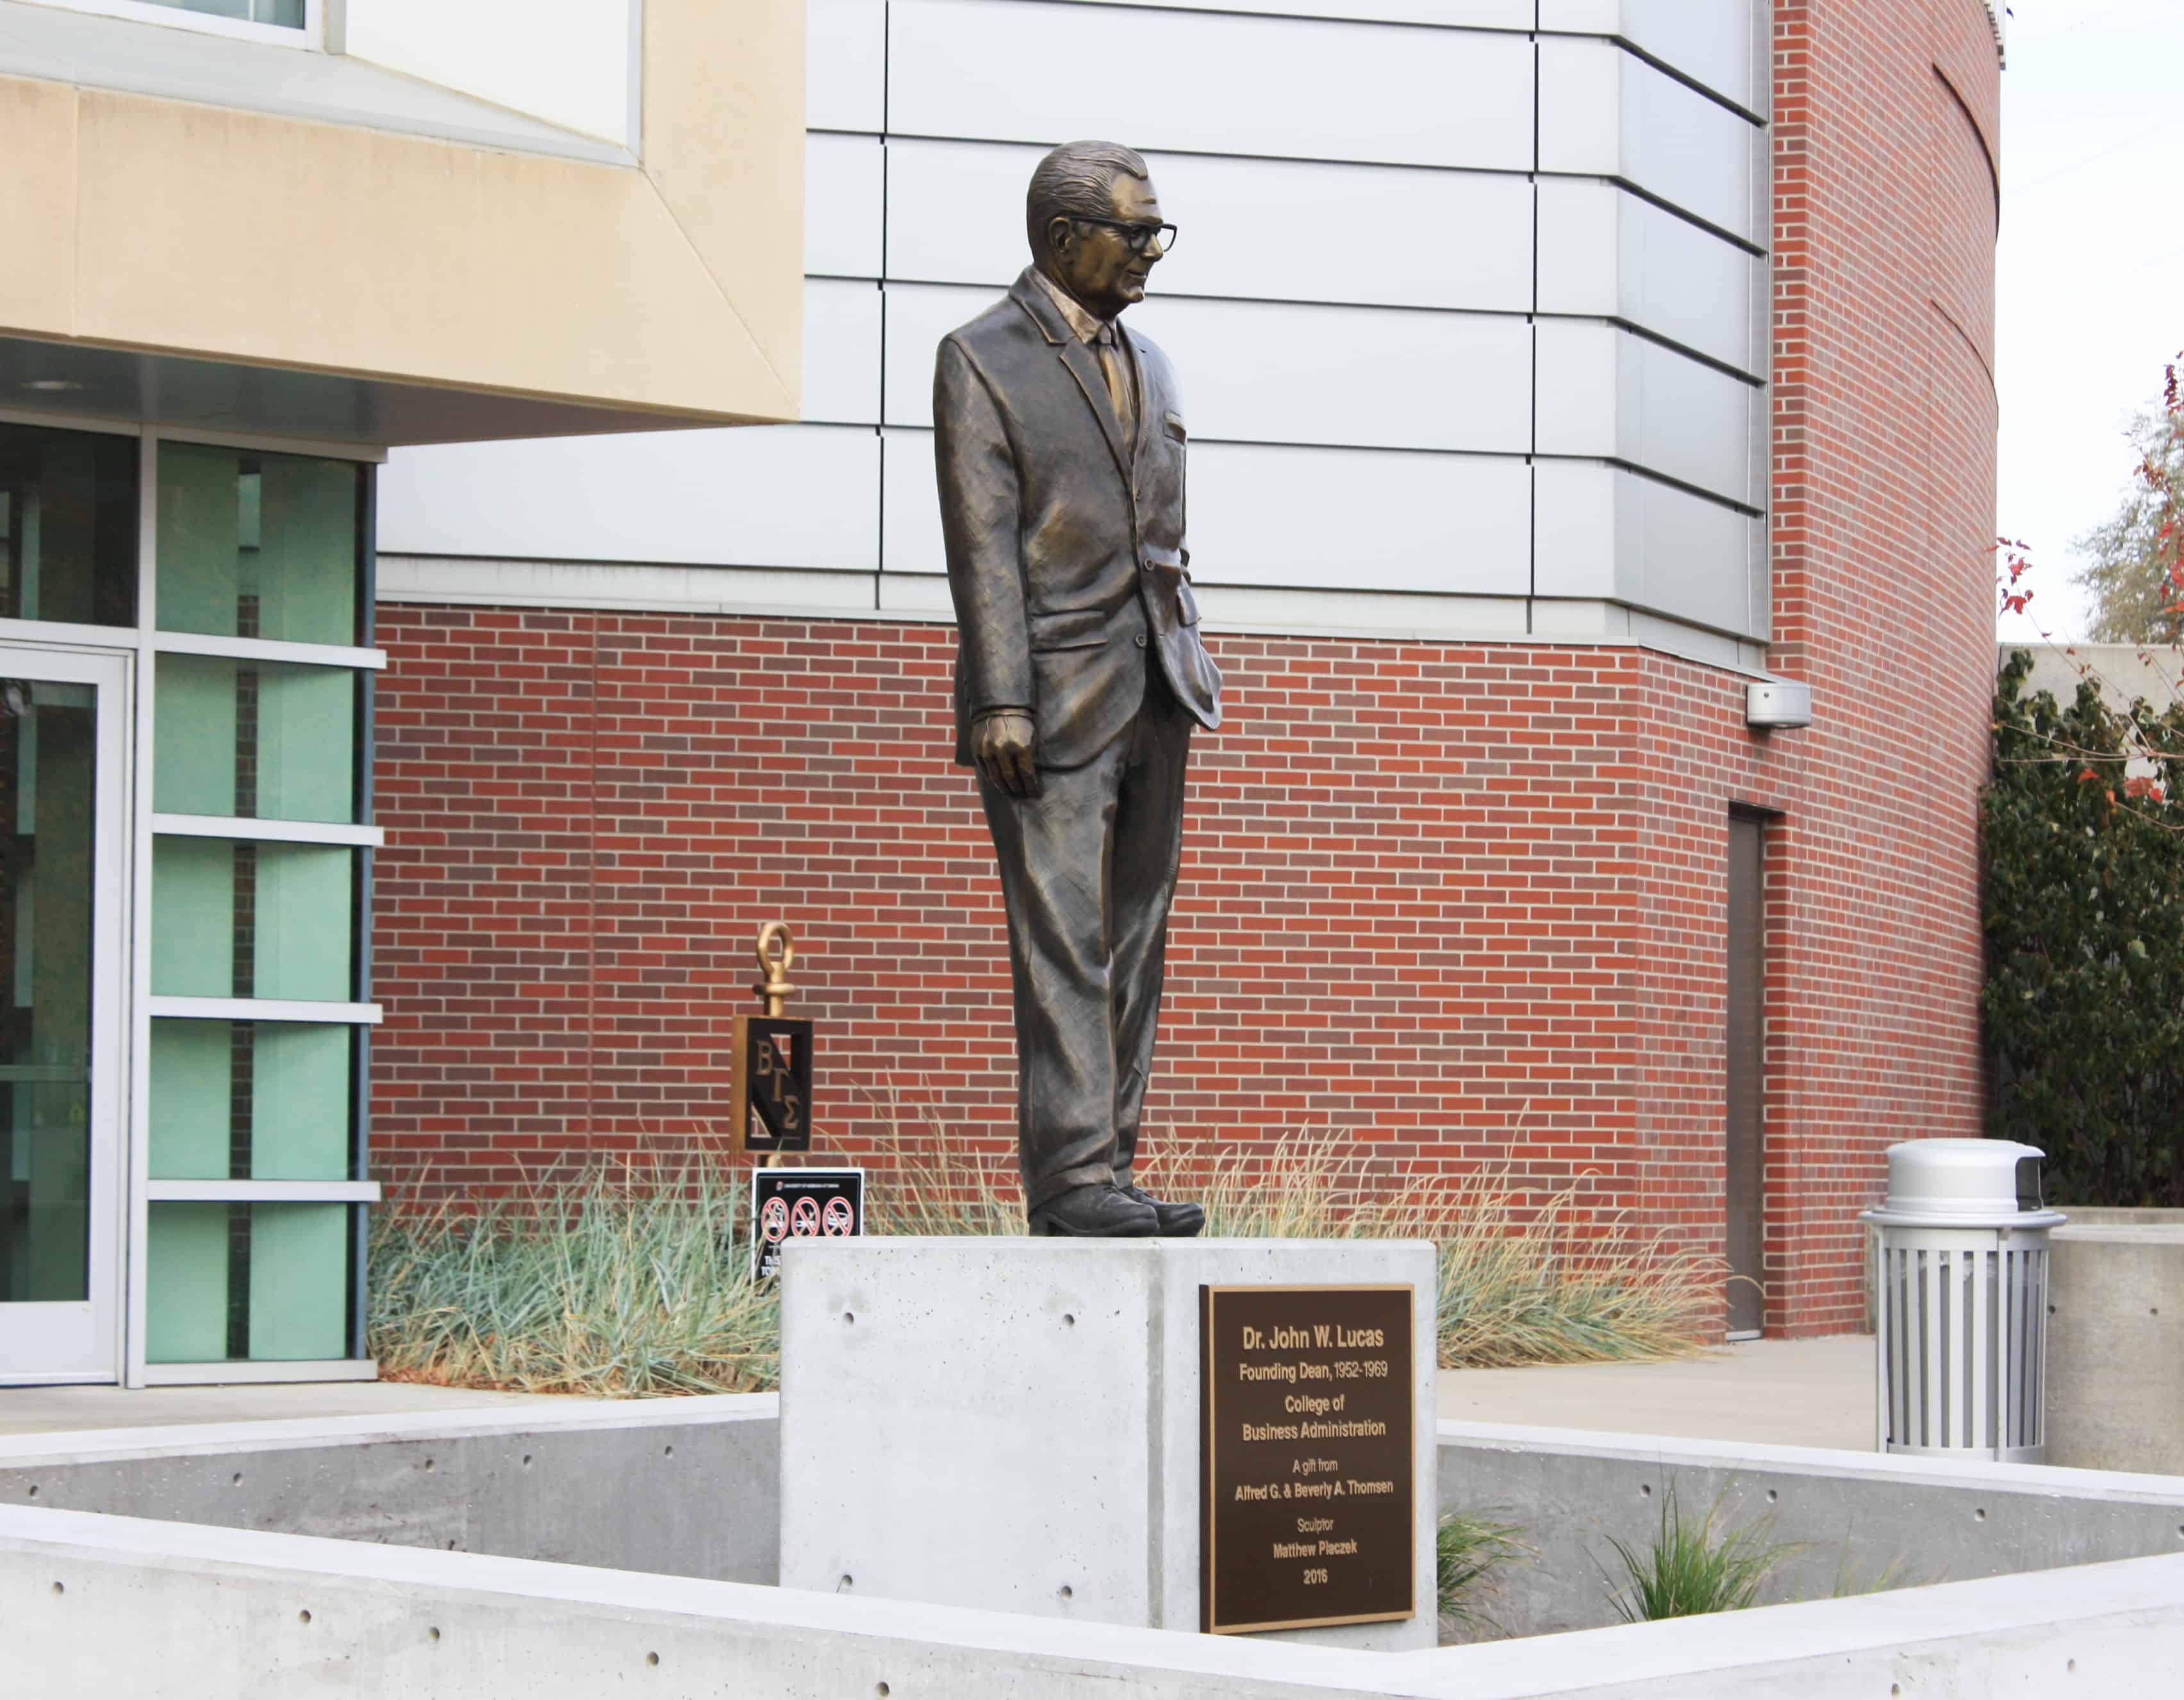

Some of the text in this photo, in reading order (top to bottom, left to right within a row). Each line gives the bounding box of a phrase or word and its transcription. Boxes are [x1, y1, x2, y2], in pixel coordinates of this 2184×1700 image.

[1243, 1324, 1384, 1349] Dr. John W. Lucas
[1239, 1360, 1388, 1384] Founding Dean, 1952-1969
[1284, 1393, 1345, 1416] College of
[1242, 1419, 1386, 1442] Business Administration
[1292, 1458, 1338, 1477] A gift from
[1235, 1479, 1394, 1501] Alfred G. & Beverly A. Thomsen
[1297, 1517, 1334, 1534] Sculptor
[1273, 1538, 1357, 1558] Matthew Placzek
[1303, 1569, 1328, 1585] 2016
